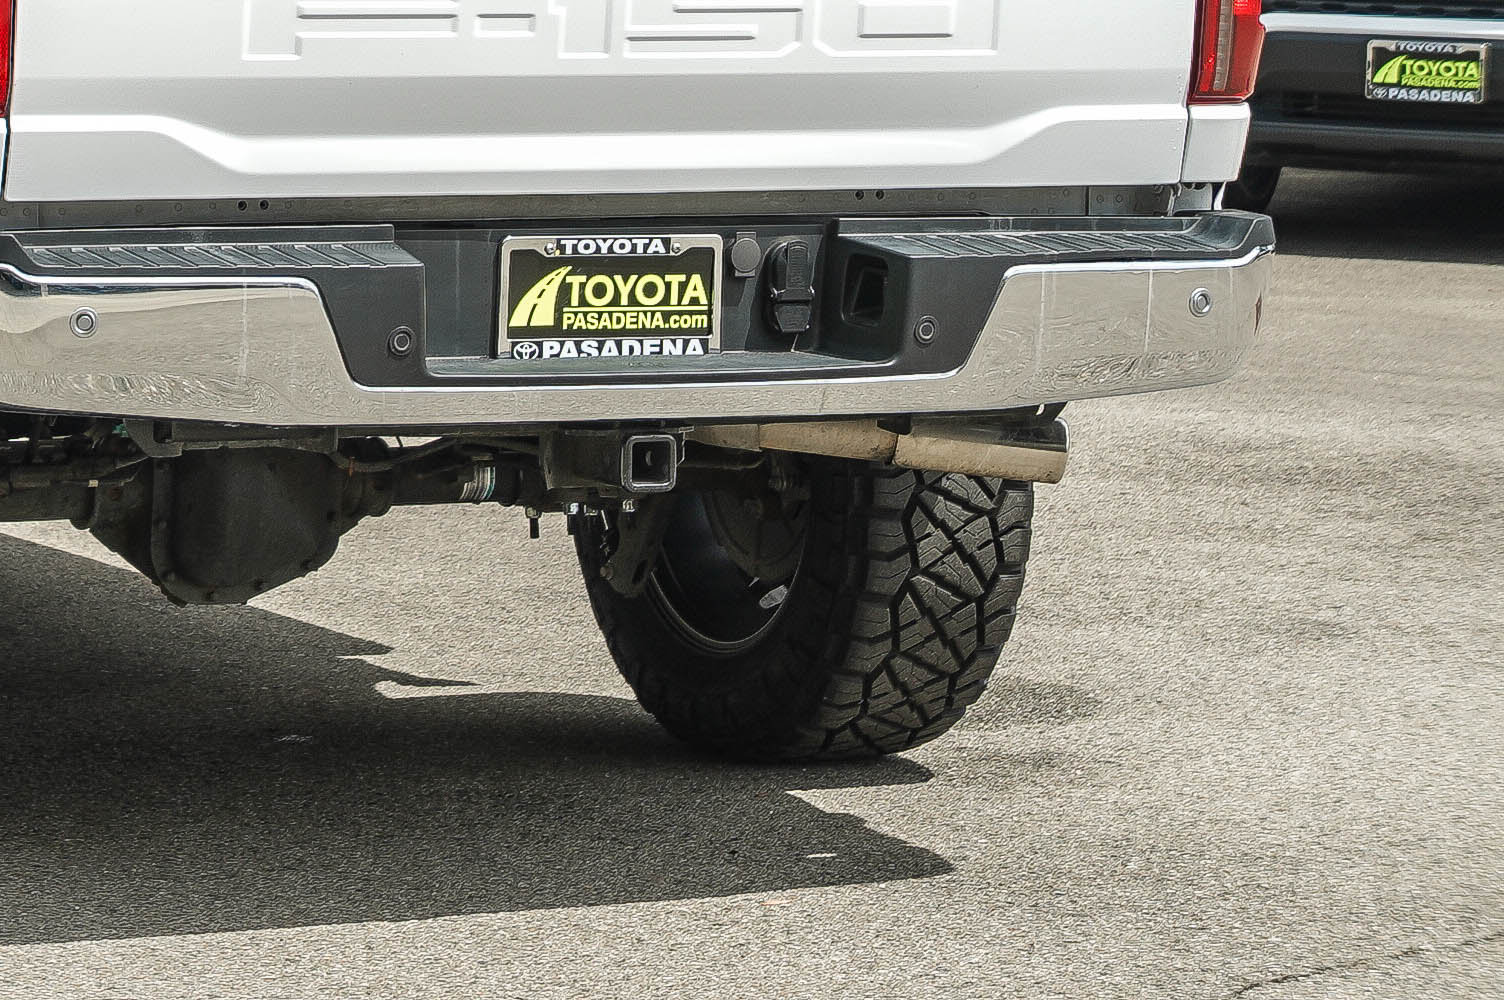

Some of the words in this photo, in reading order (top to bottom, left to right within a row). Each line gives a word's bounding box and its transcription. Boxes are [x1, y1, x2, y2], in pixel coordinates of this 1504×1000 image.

[1397, 41, 1453, 53] TOYOTA
[1401, 60, 1480, 78] TOYOTA
[1388, 88, 1475, 102] PASADENA
[560, 239, 666, 254] TOYOTA
[565, 274, 708, 307] TOYOTA
[562, 311, 708, 330] PASADENA.com
[543, 339, 705, 359] PASADENA
